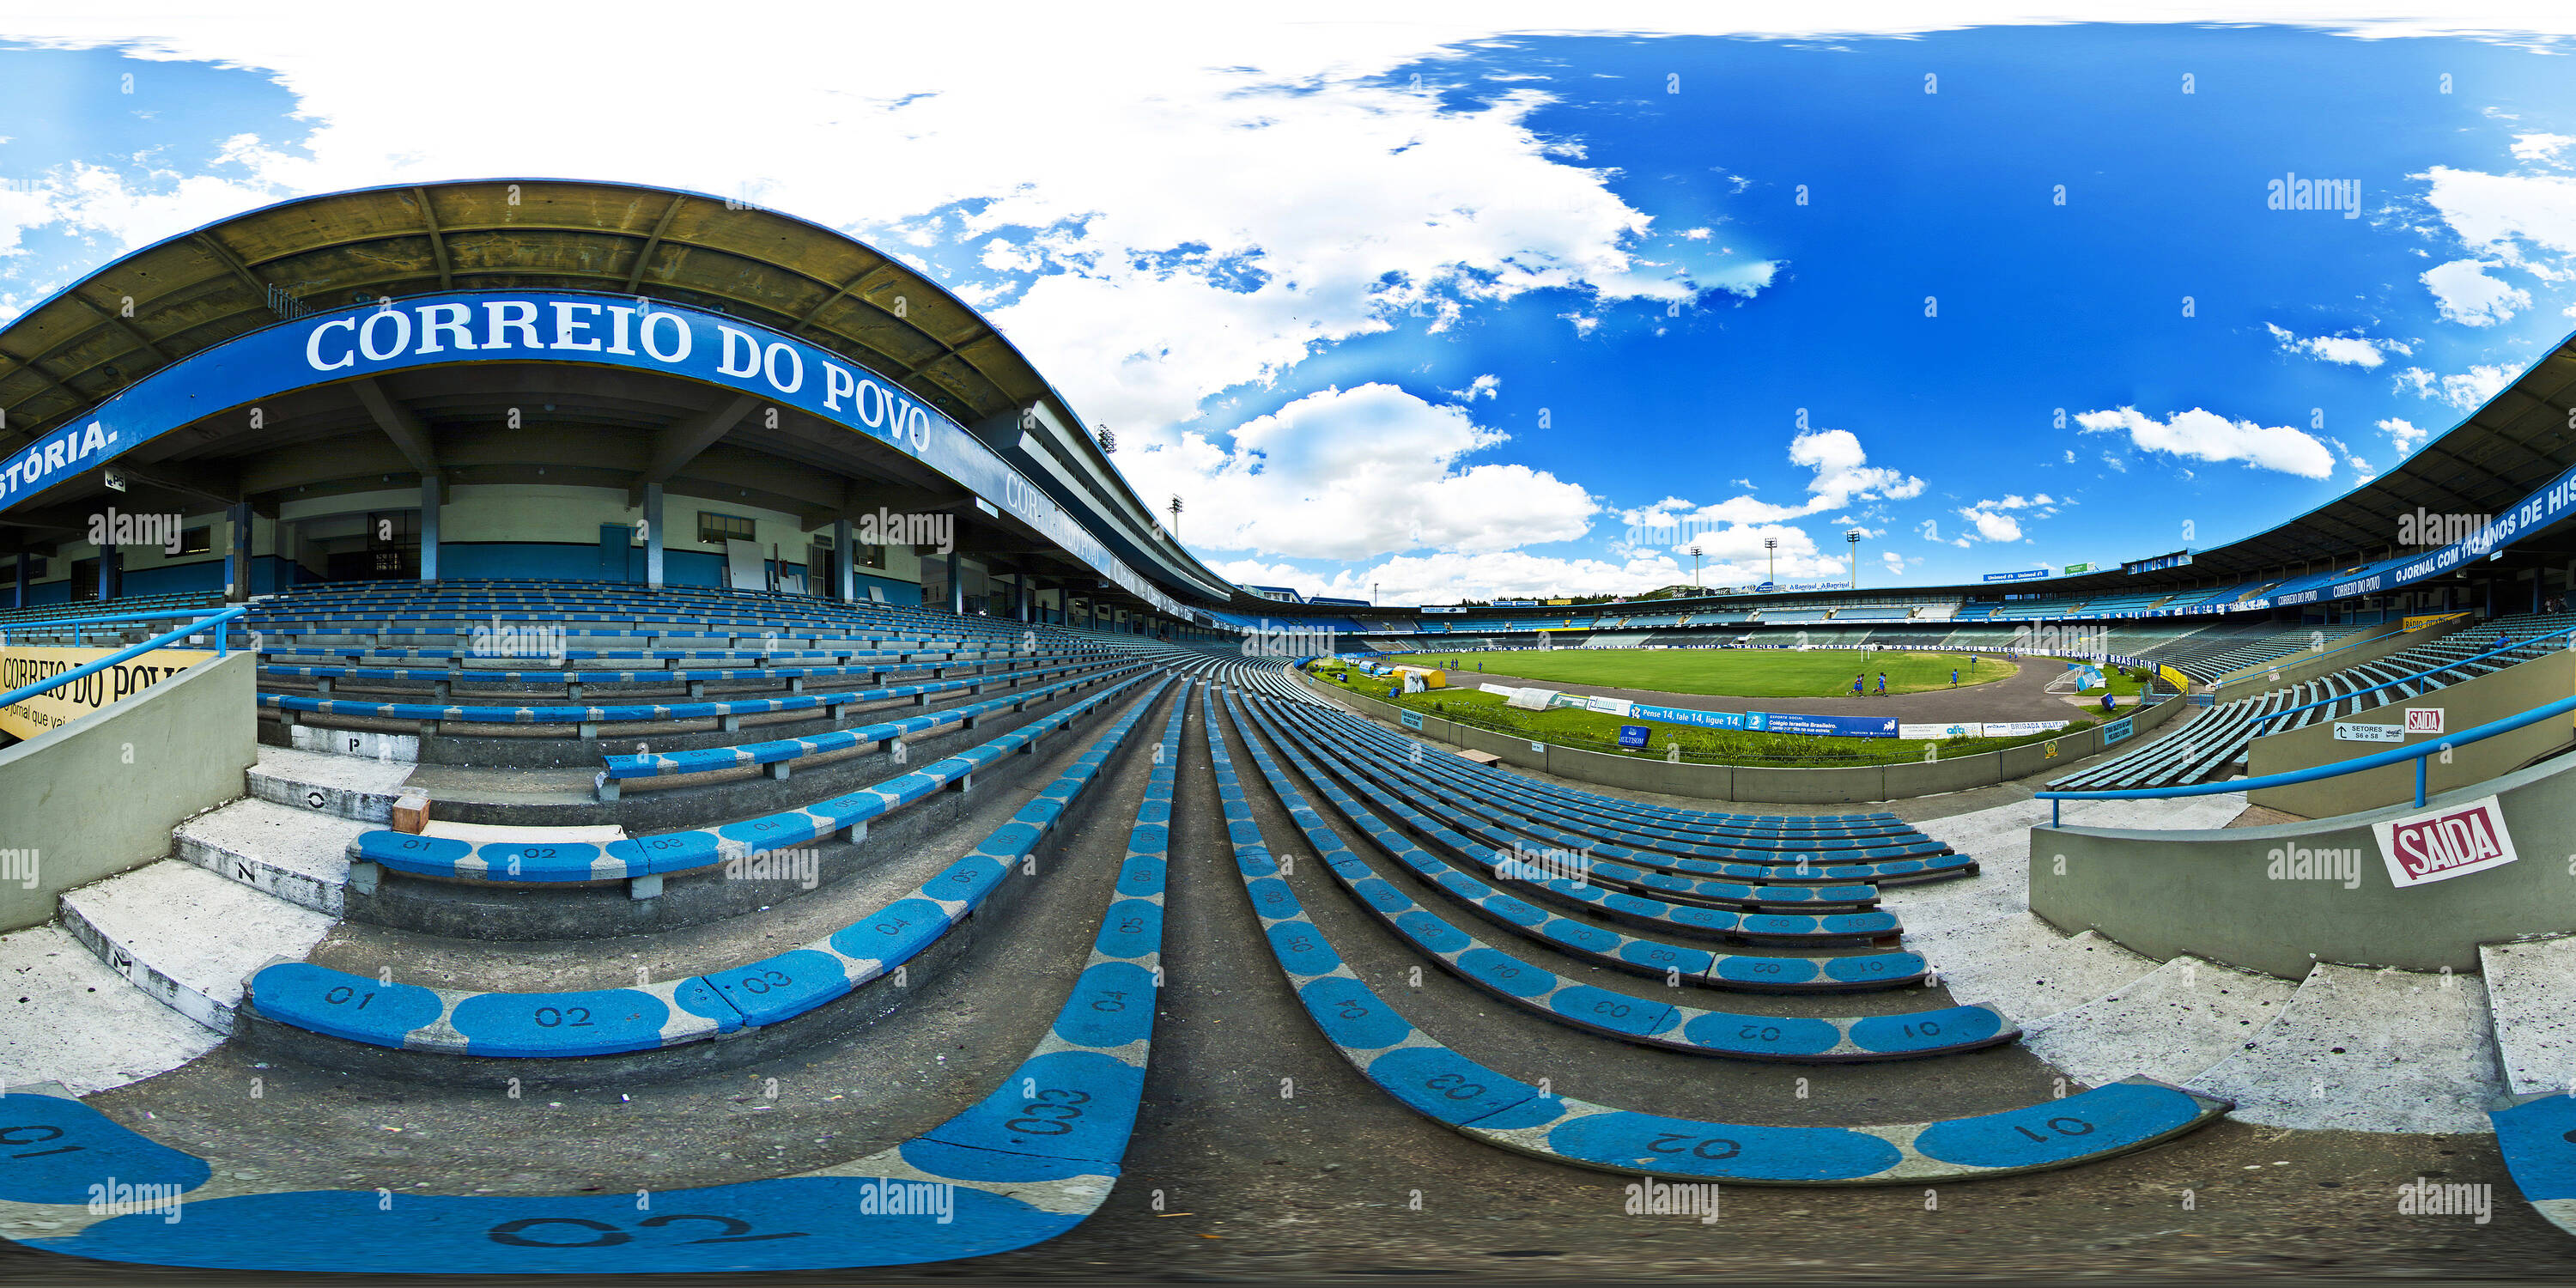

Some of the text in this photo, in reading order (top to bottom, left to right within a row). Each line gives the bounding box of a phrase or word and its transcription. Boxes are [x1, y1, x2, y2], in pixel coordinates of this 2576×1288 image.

[306, 301, 930, 453] CORREIO DO POVO
[112, 474, 125, 487] P5
[2396, 570, 2403, 583] O
[2402, 560, 2436, 582] JORNAL
[2437, 547, 2459, 569] COM
[2461, 537, 2480, 559] 110
[2480, 513, 2517, 550] ANOS
[2520, 496, 2543, 529] DE
[2333, 575, 2380, 598] CORREIO DO POVO
[2278, 592, 2297, 605] CORREIO
[2304, 590, 2318, 602] POVO
[2111, 654, 2157, 673] BRASILEIRO
[73, 663, 104, 708] DO
[10, 702, 31, 724] jornal
[33, 713, 49, 730] que
[1643, 709, 1661, 719] Pense
[1663, 710, 1674, 720] 14,
[1676, 712, 1689, 721] fale
[1692, 713, 1704, 724] 14,
[1706, 715, 1724, 726] ligue
[1727, 716, 1741, 726] 14.
[349, 738, 360, 752] P
[308, 792, 325, 809] O
[835, 799, 859, 810] 05
[754, 819, 781, 832] 04
[655, 839, 684, 850] 03
[998, 833, 1019, 846] 06
[2398, 812, 2500, 875] SAÍDA
[523, 848, 557, 859] 02
[238, 861, 256, 884] N
[951, 868, 979, 884] 05
[1133, 869, 1152, 883] 06
[876, 916, 912, 938] 04
[1119, 916, 1144, 934] 05
[1417, 921, 1443, 938] 05
[1286, 935, 1314, 953] 05
[1649, 950, 1677, 962] 03
[1492, 963, 1521, 980] 04
[1753, 963, 1781, 975] 02
[1860, 961, 1886, 975] 01
[742, 970, 793, 995] 03
[325, 985, 376, 1011] 01
[1091, 989, 1127, 1014] 04
[534, 1006, 593, 1029] 02
[1334, 998, 1369, 1020] 04
[1593, 1000, 1631, 1019] 03
[1738, 1024, 1781, 1042] 02
[1903, 1021, 1941, 1039] 01
[1425, 1072, 1487, 1101] 03
[2014, 1116, 2096, 1145] 01
[1647, 1133, 1742, 1161] 02
